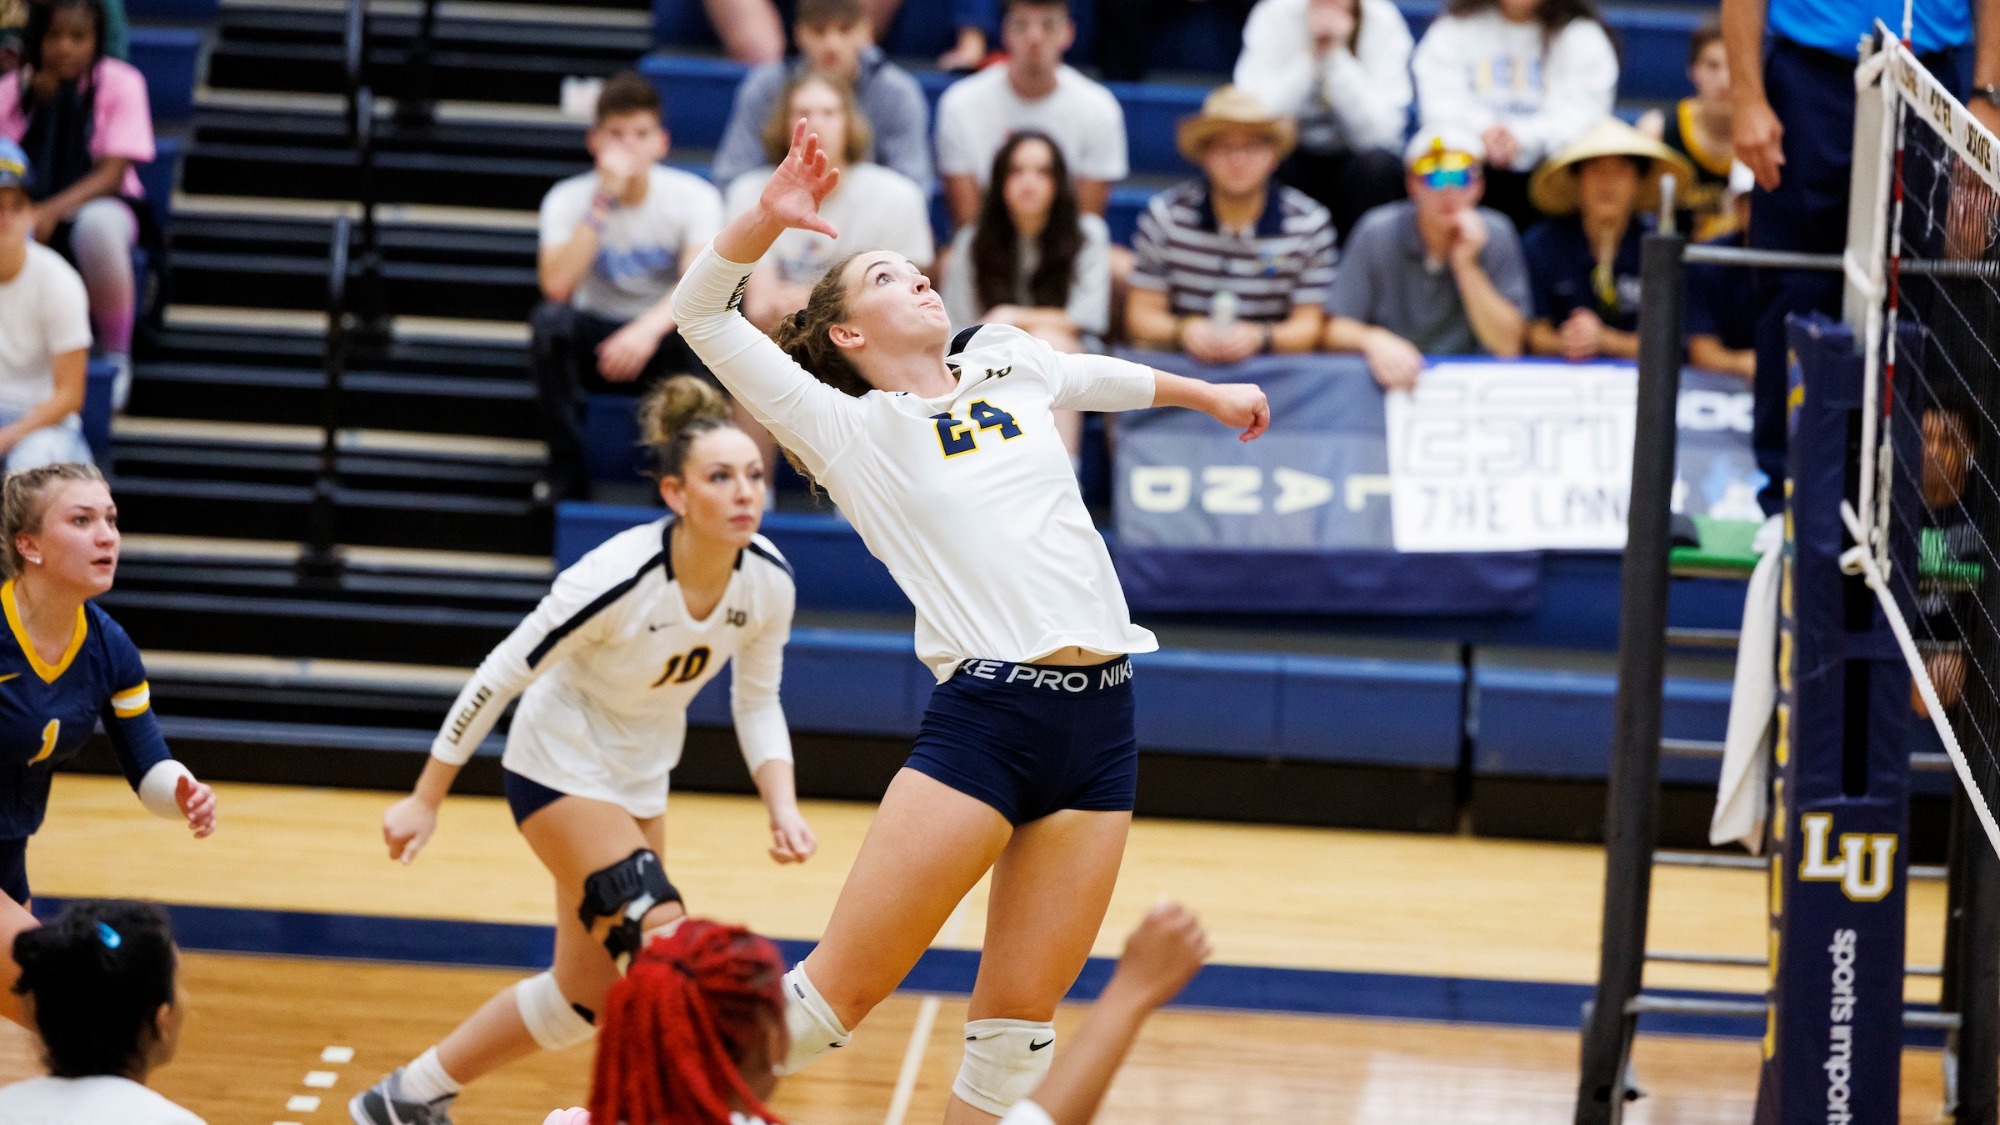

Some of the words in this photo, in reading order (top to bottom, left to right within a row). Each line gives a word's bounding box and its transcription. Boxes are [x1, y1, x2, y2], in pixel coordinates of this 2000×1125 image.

[928, 397, 1026, 460] 24
[1418, 483, 1506, 533] THE
[1529, 483, 1628, 532] LAN
[650, 644, 712, 689] 10
[959, 659, 1005, 680] KE
[1006, 665, 1089, 693] PRO
[27, 717, 61, 768] 1
[1799, 812, 1899, 902] LU
[1828, 928, 1857, 1023] sports
[1822, 1025, 1853, 1125] import
